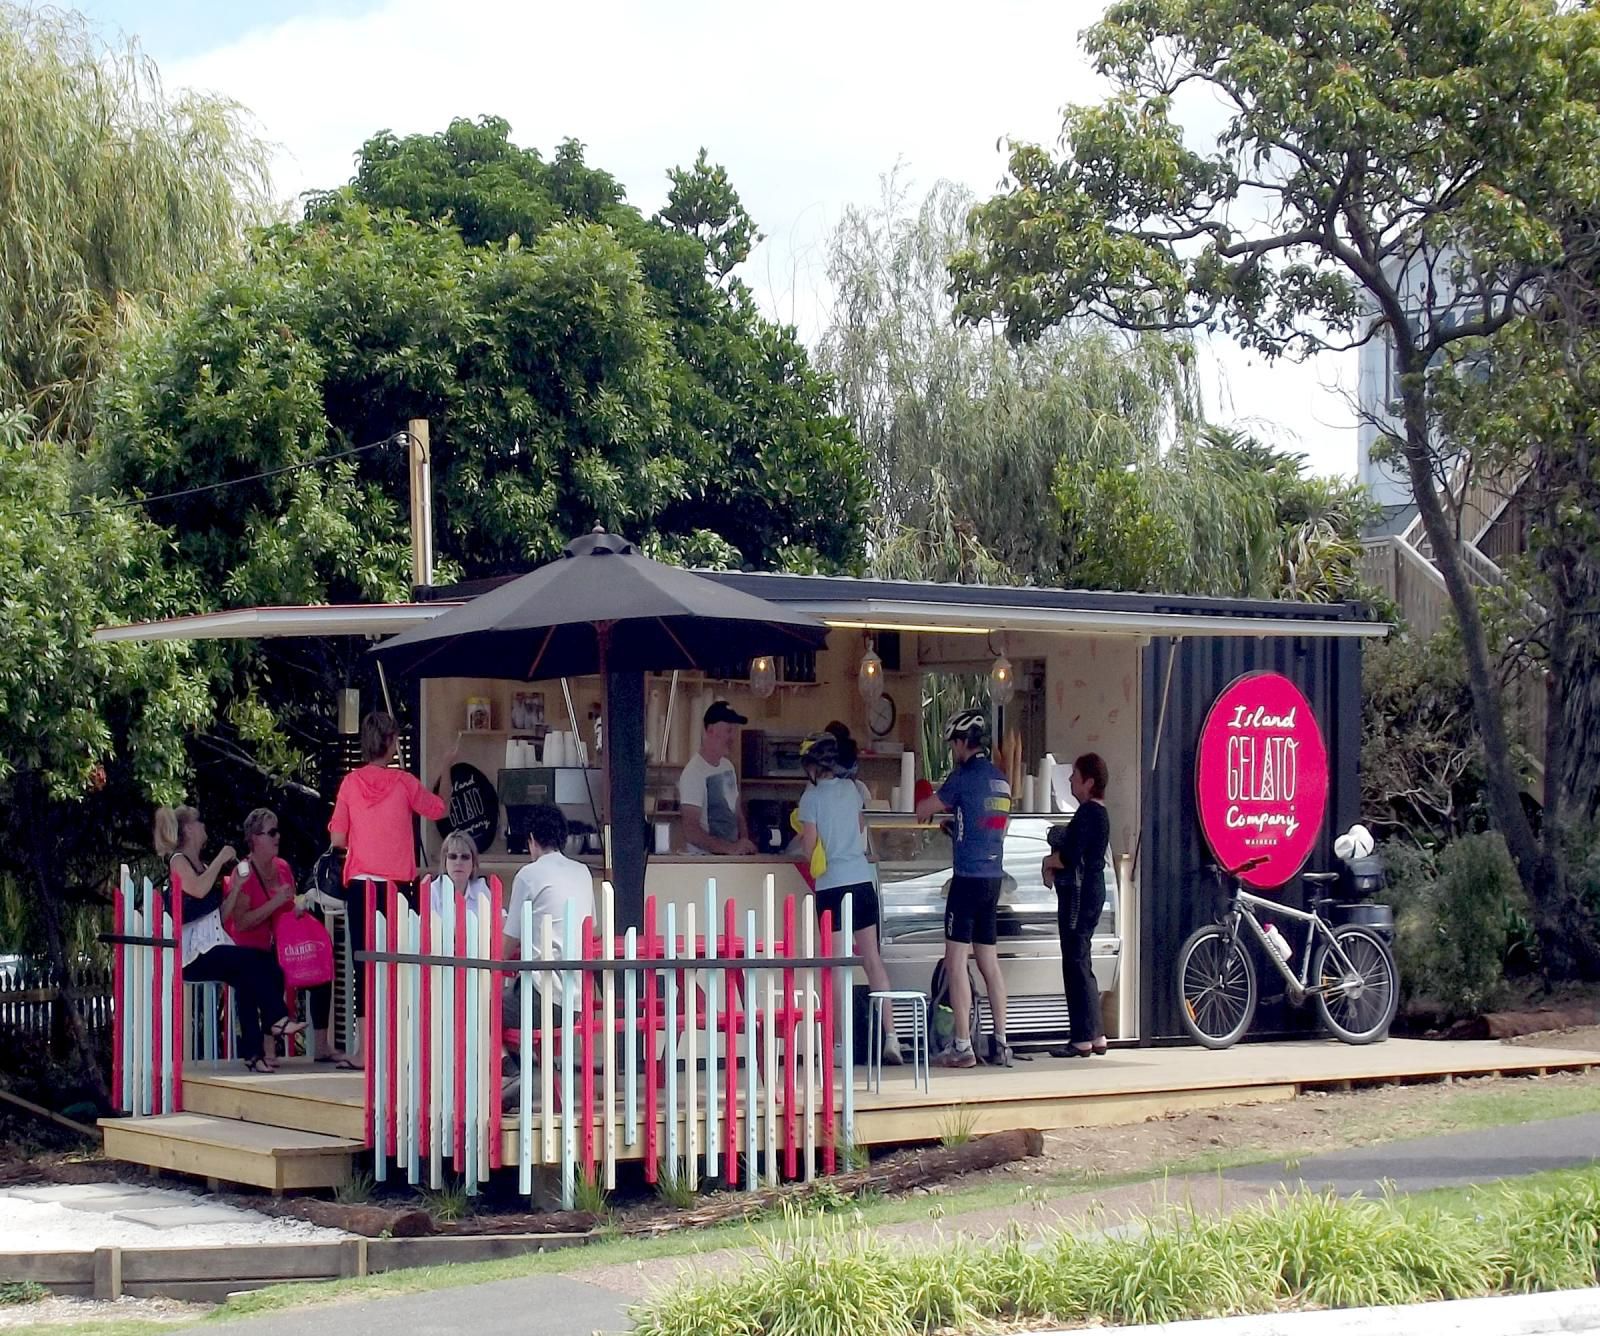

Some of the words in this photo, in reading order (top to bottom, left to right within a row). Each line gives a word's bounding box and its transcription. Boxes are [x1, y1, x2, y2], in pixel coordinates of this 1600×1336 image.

[1227, 705, 1296, 729] Island
[1227, 735, 1299, 801] GELATO
[451, 774, 475, 792] land
[1226, 805, 1299, 837] Company
